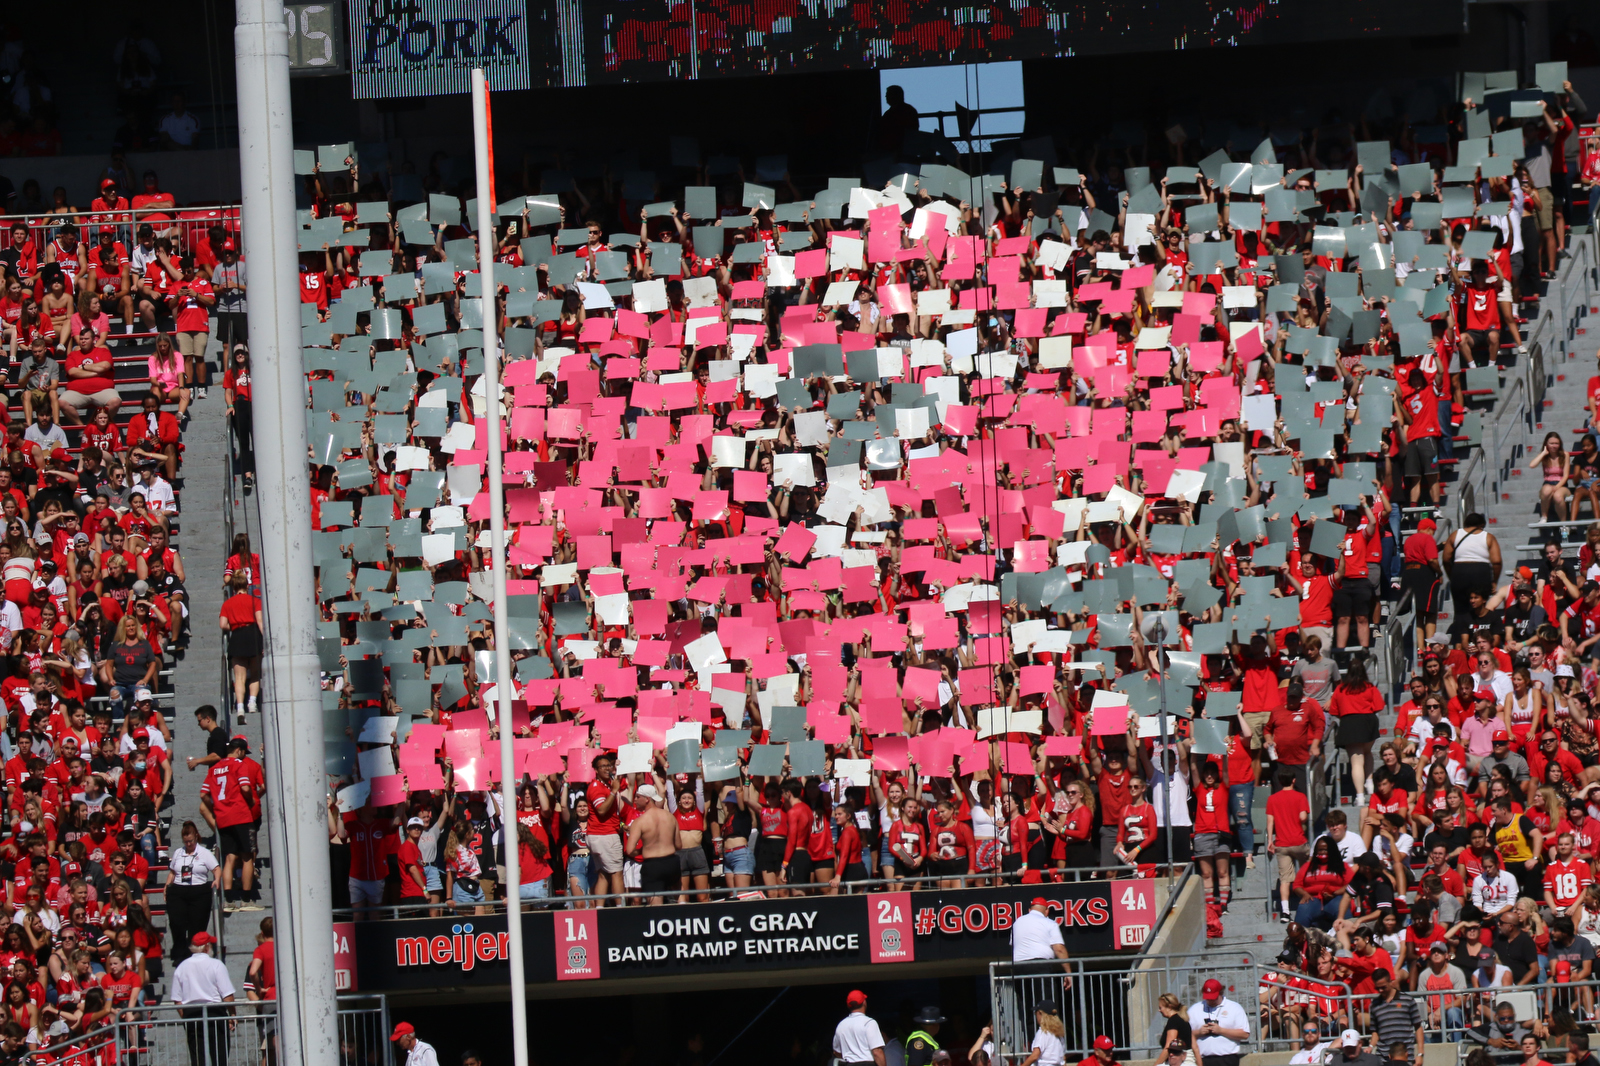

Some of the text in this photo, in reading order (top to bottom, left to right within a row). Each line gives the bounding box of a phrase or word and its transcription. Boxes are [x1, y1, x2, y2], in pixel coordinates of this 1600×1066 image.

[361, 14, 521, 64] PORK
[305, 275, 319, 290] 15
[1474, 294, 1487, 310] 2
[1114, 350, 1128, 366] 3
[1410, 395, 1423, 414] 5
[1344, 538, 1354, 556] 1
[1302, 580, 1311, 600] 1
[217, 776, 227, 801] 7
[1205, 789, 1215, 812] 1
[469, 834, 483, 856] 2
[1555, 873, 1579, 899] 18
[1120, 886, 1147, 911] 4A
[877, 900, 903, 924] 2A
[565, 917, 588, 942] 1A
[642, 911, 818, 940] JOHN C. GRAY
[1126, 927, 1145, 943] EXIT
[396, 923, 509, 972] meijer
[607, 932, 860, 963] BAND RAMP ENTRANCE
[879, 950, 906, 958] NORTH
